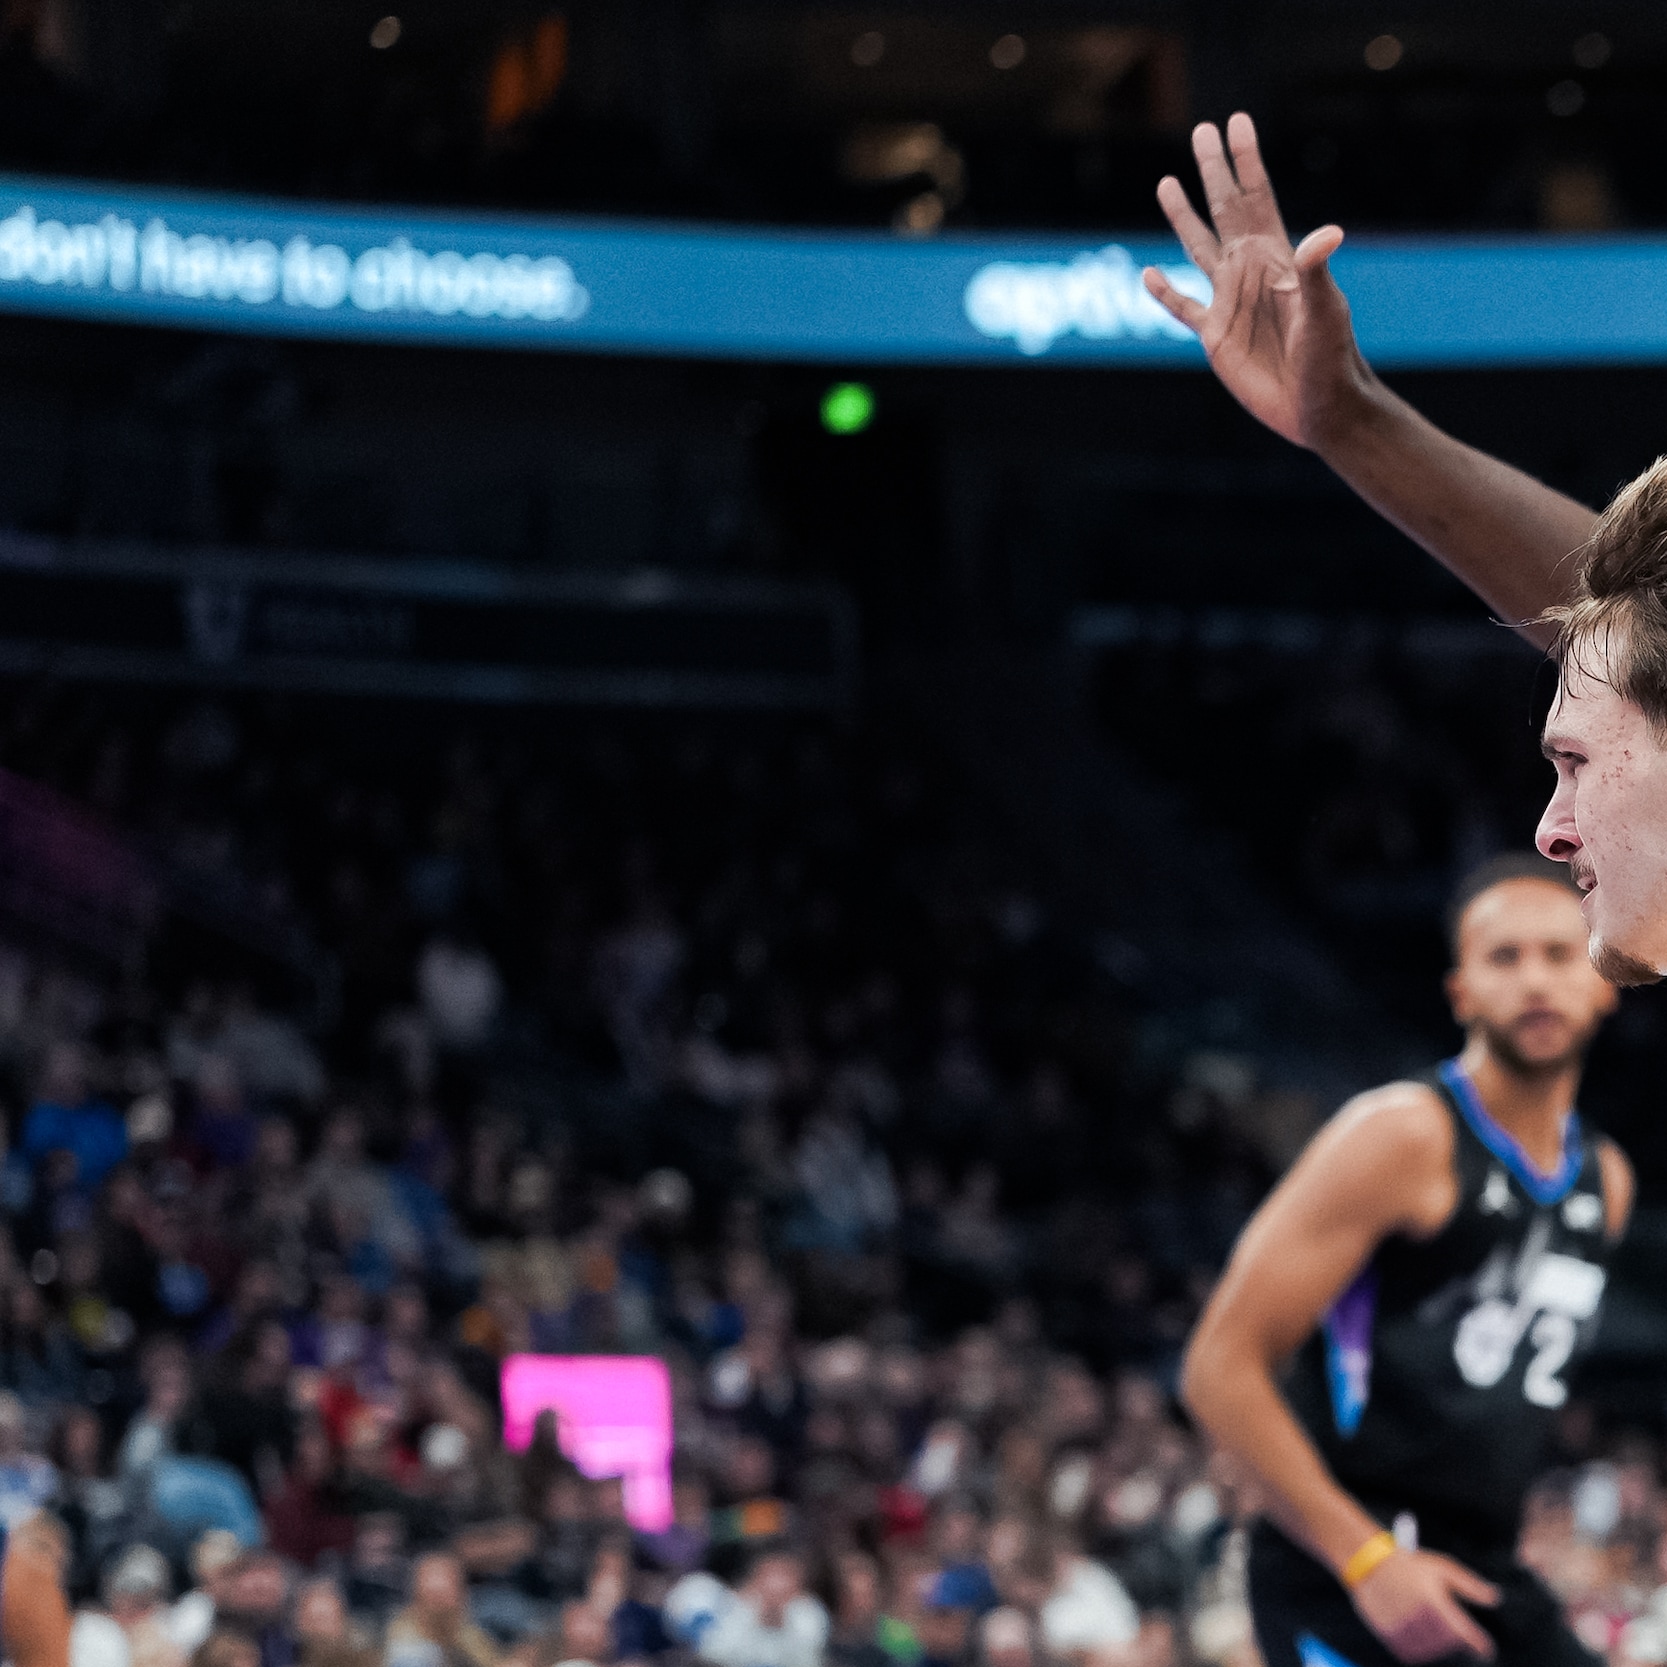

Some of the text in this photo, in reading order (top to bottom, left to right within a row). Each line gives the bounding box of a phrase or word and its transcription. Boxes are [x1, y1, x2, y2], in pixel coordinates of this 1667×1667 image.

[141, 216, 280, 304] have
[283, 234, 350, 309] to
[1522, 1310, 1577, 1409] 2
